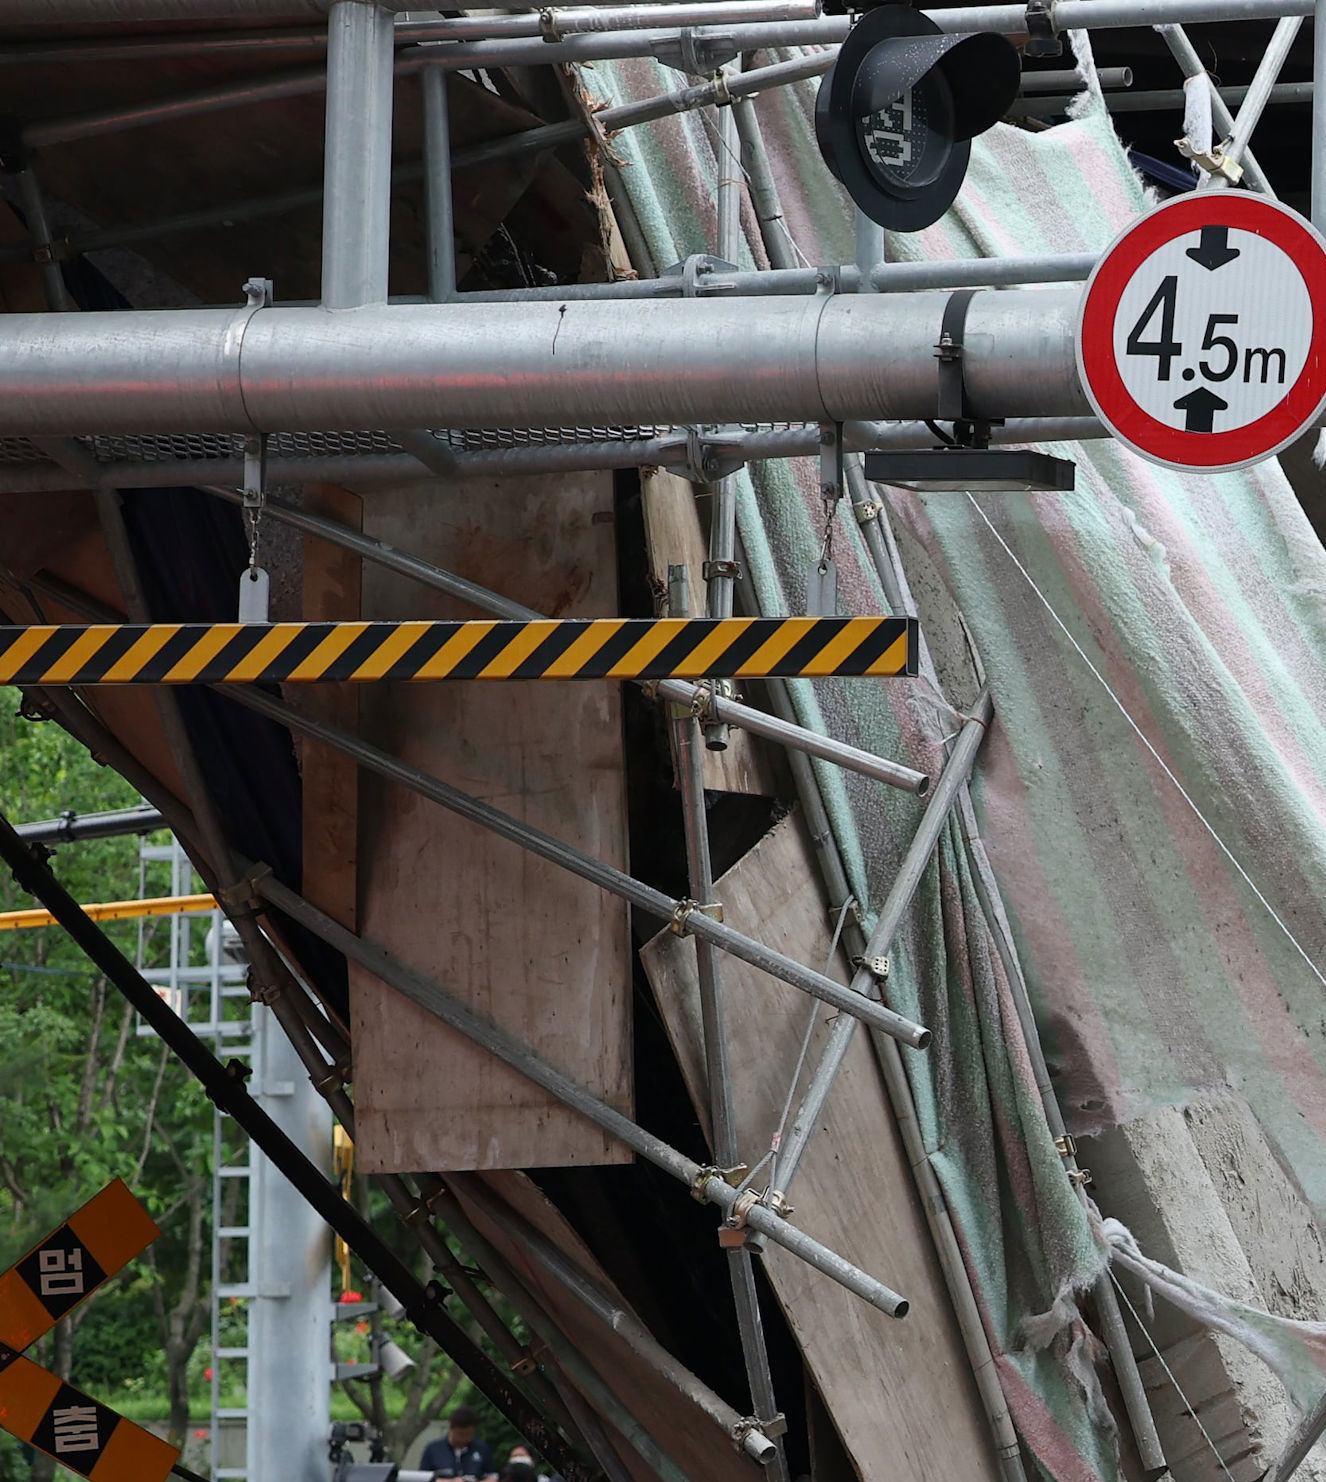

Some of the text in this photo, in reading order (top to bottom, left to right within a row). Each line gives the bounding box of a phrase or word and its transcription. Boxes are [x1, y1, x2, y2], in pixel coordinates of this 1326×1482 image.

[1126, 275, 1286, 384] 4.5m
[38, 1247, 85, 1296] 멈
[52, 1405, 100, 1454] 춤
